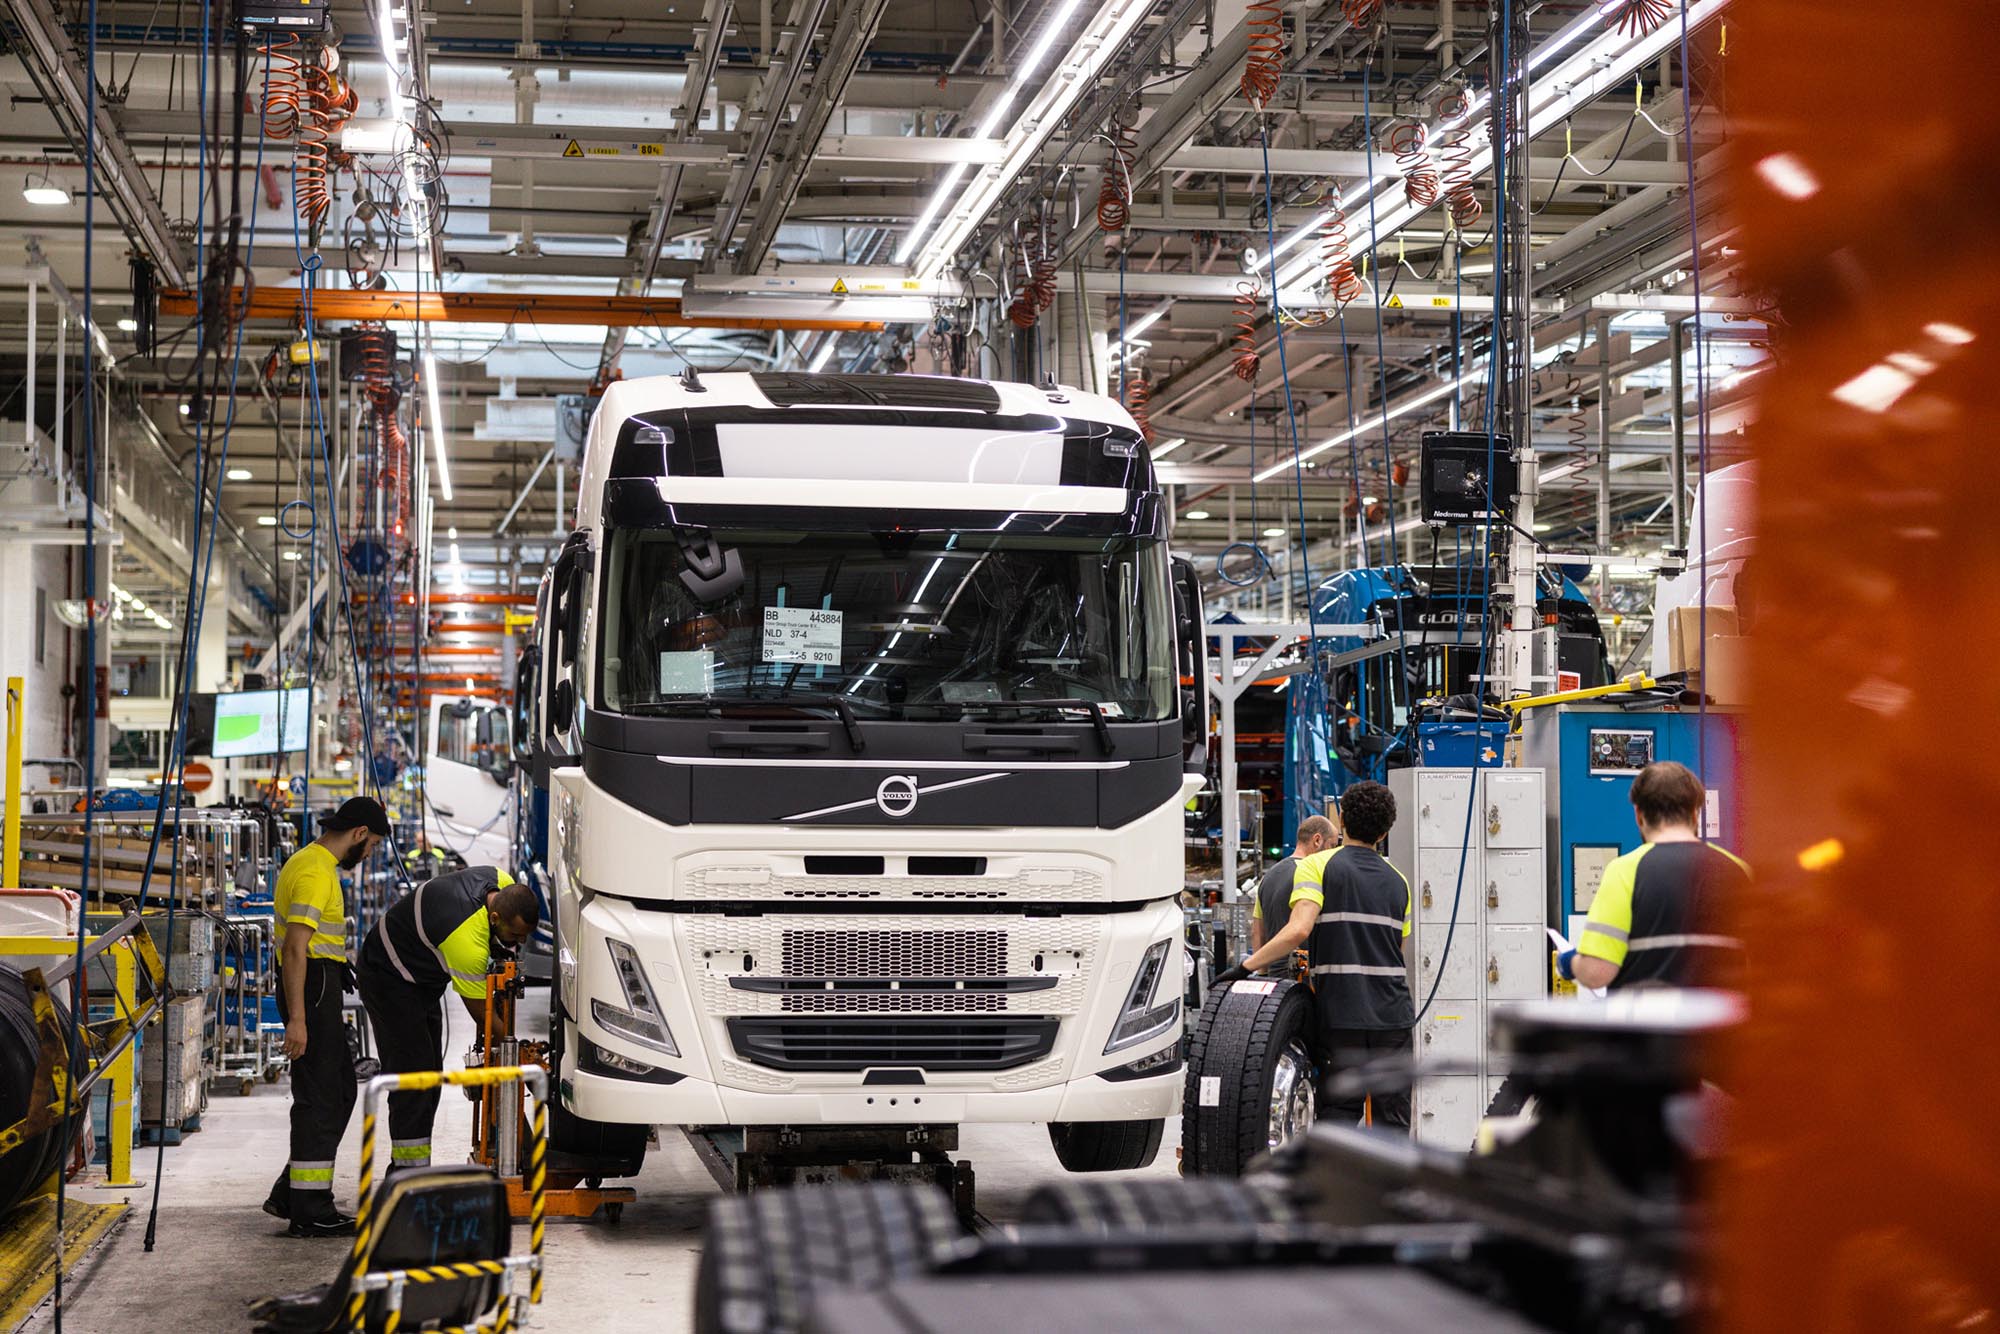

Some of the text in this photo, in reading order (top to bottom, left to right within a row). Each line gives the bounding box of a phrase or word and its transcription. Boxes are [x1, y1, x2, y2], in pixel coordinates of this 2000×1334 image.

[766, 611, 841, 624] BB 443884
[1418, 613, 1493, 624] GLOBET
[765, 629, 808, 639] NLD 37-4
[813, 651, 833, 662] 9210
